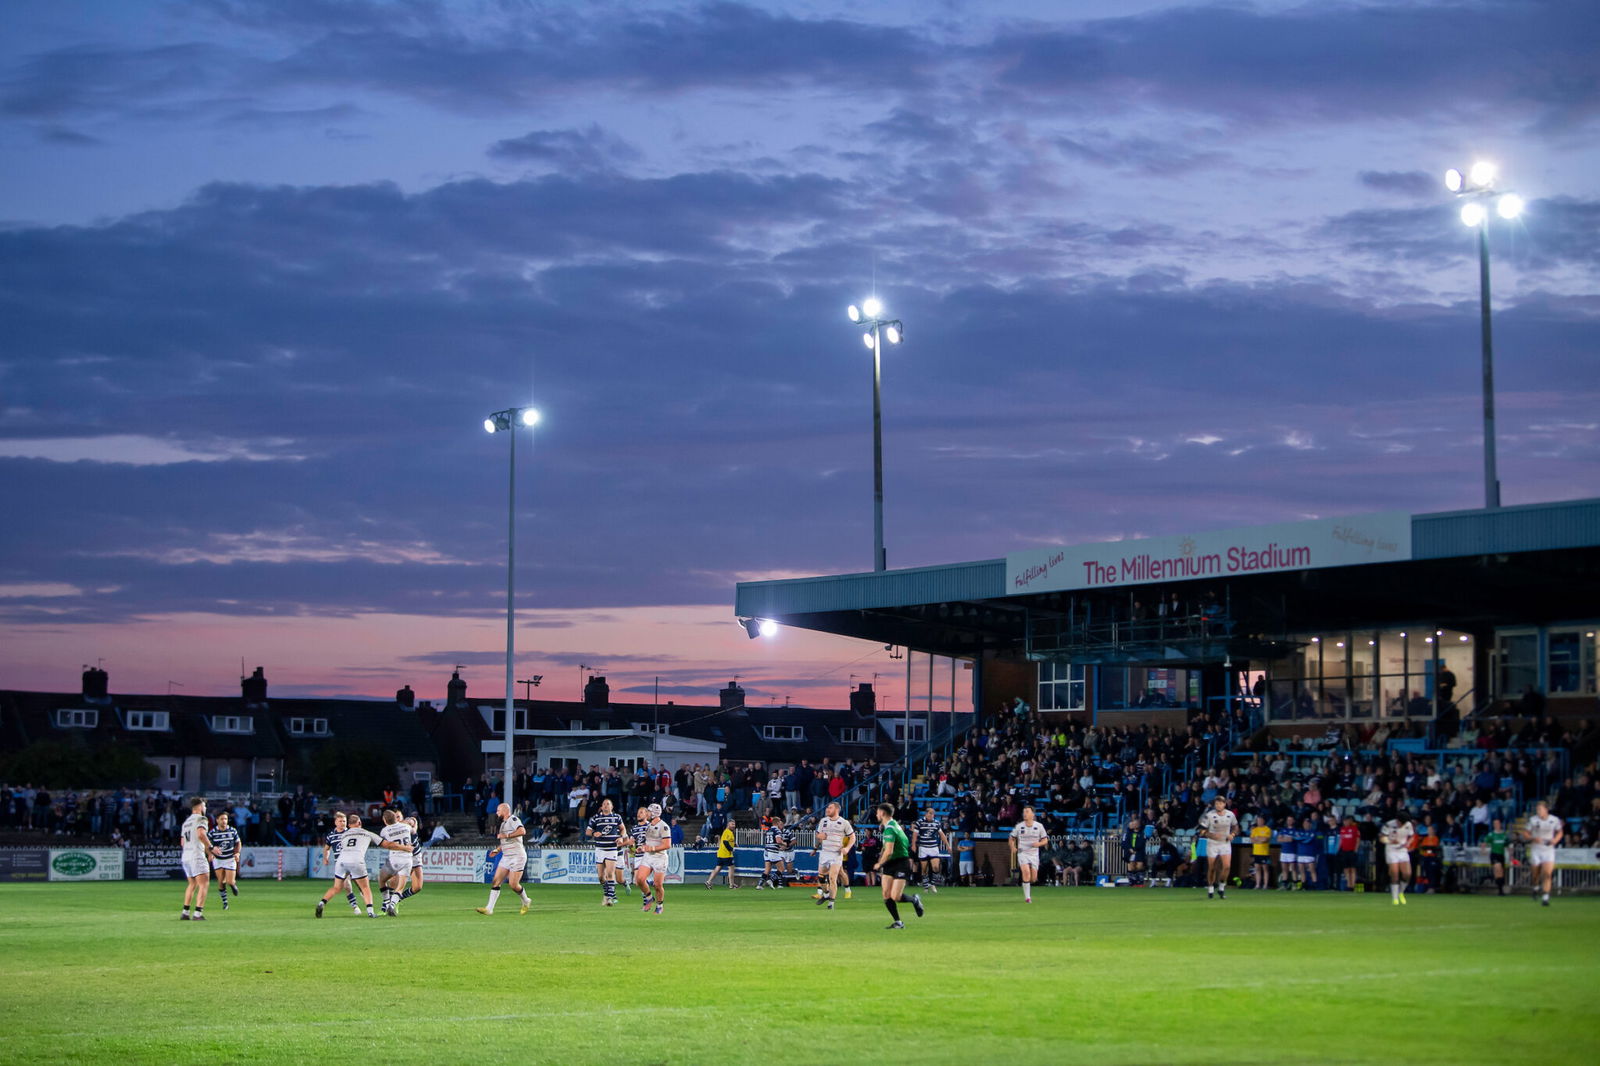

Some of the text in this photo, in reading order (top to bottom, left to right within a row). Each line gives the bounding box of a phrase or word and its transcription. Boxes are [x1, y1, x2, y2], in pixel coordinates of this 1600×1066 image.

[1083, 543, 1311, 585] The Millennium Stadium
[1015, 561, 1048, 589] Fulfilling
[347, 838, 357, 847] 8
[766, 835, 774, 844] 13
[137, 850, 155, 858] LHC
[430, 851, 474, 867] CARPETS
[568, 852, 582, 865] OVEN
[583, 852, 588, 864] &
[138, 858, 145, 866] &
